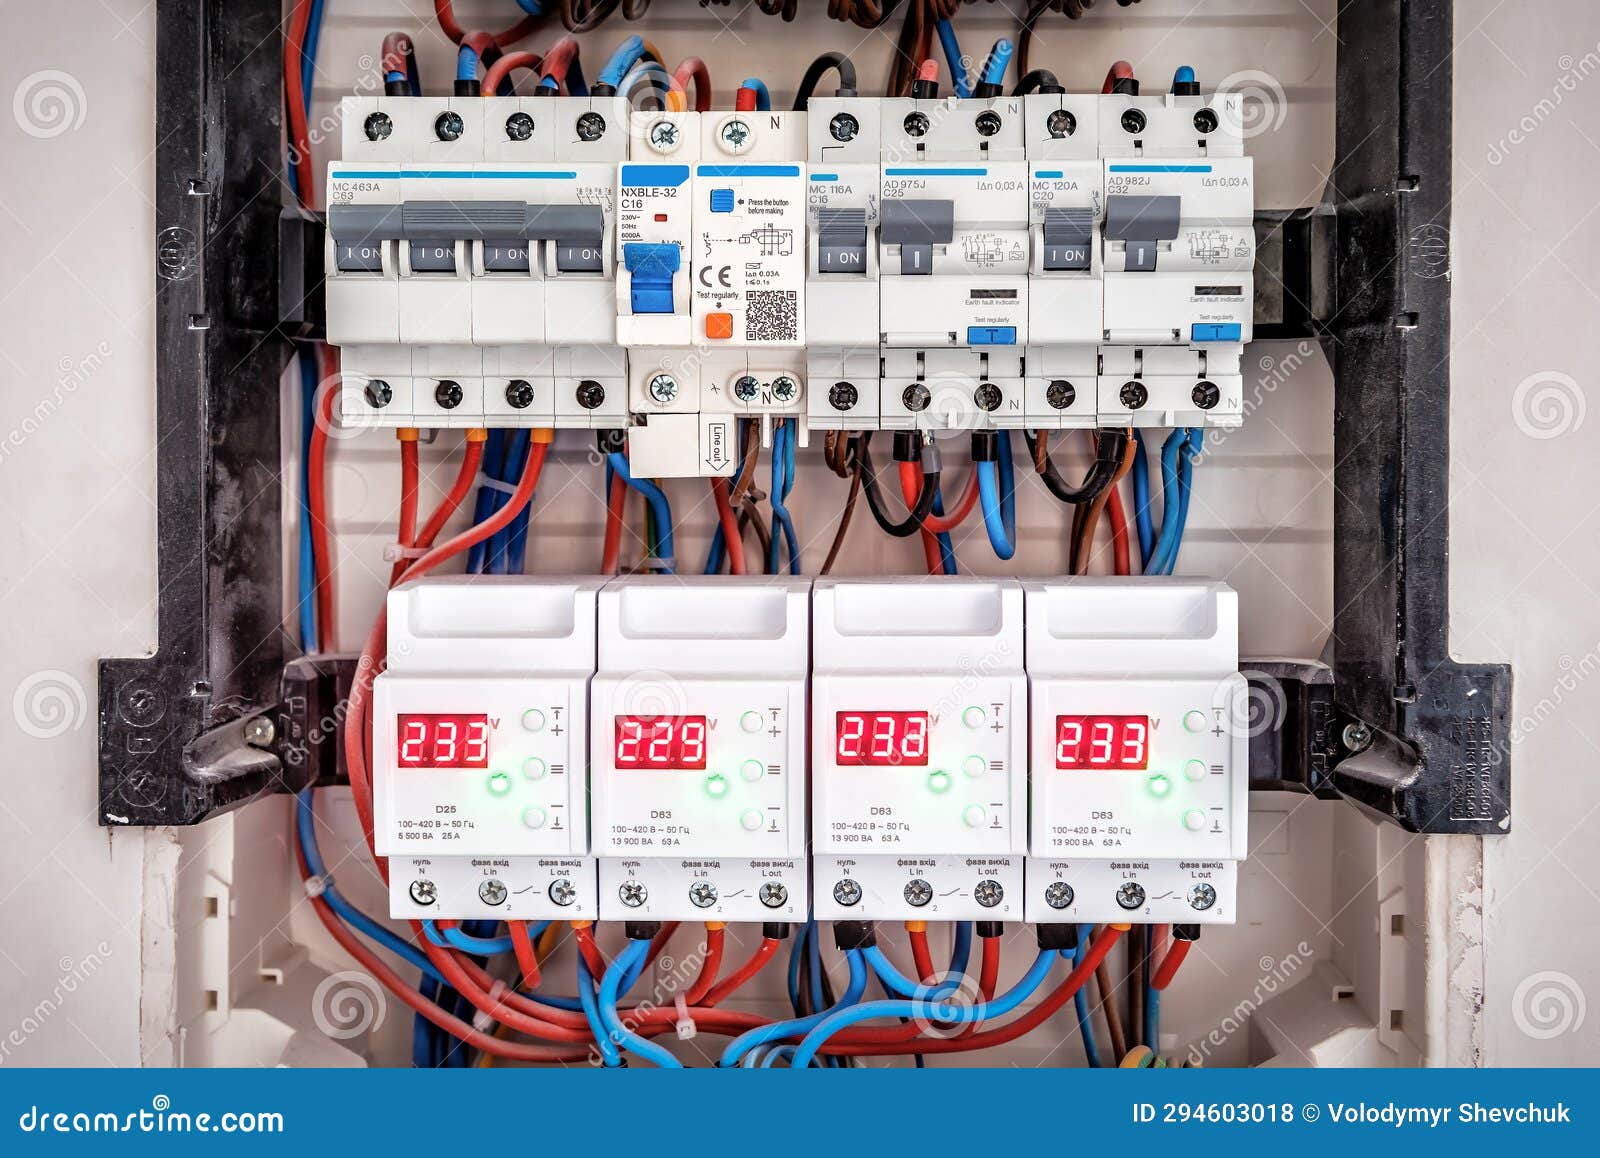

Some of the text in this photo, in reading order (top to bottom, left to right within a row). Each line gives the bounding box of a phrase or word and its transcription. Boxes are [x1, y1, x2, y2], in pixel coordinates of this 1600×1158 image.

[1008, 104, 1018, 114] N
[1226, 100, 1236, 110] N
[770, 116, 780, 130] N
[884, 180, 926, 189] AD 975J
[1032, 182, 1078, 190] MC 120A
[1108, 177, 1150, 186] AD 982J
[332, 183, 380, 191] MC 463A
[810, 185, 852, 194] MC 116A
[1108, 185, 1128, 194] C32
[332, 192, 354, 200] C63
[621, 188, 677, 198] NXBLE-32
[884, 189, 904, 197] C25
[1033, 192, 1054, 200] C20
[621, 200, 643, 208] C16
[748, 198, 789, 206] Press the button
[810, 195, 828, 204] C16
[764, 207, 784, 216] making
[840, 252, 860, 264] ON
[1065, 250, 1085, 261] ON
[699, 266, 732, 288] CE
[758, 270, 780, 278] 0.03A
[711, 292, 739, 300] regularly
[985, 329, 999, 342] T
[762, 392, 772, 404] N
[1010, 400, 1019, 410] N
[1228, 398, 1237, 408] N
[714, 426, 722, 446] Line
[490, 718, 500, 730] V
[708, 719, 718, 730] V
[930, 714, 940, 726] V
[1150, 719, 1160, 730] V
[402, 722, 488, 762] 233
[618, 722, 704, 762] 229
[1056, 722, 1146, 763] 233
[452, 820, 462, 828] 50
[464, 820, 474, 829] Гц
[886, 822, 896, 830] 50
[899, 822, 910, 831] Гц
[679, 826, 689, 834] Гц
[1120, 827, 1131, 835] Гц
